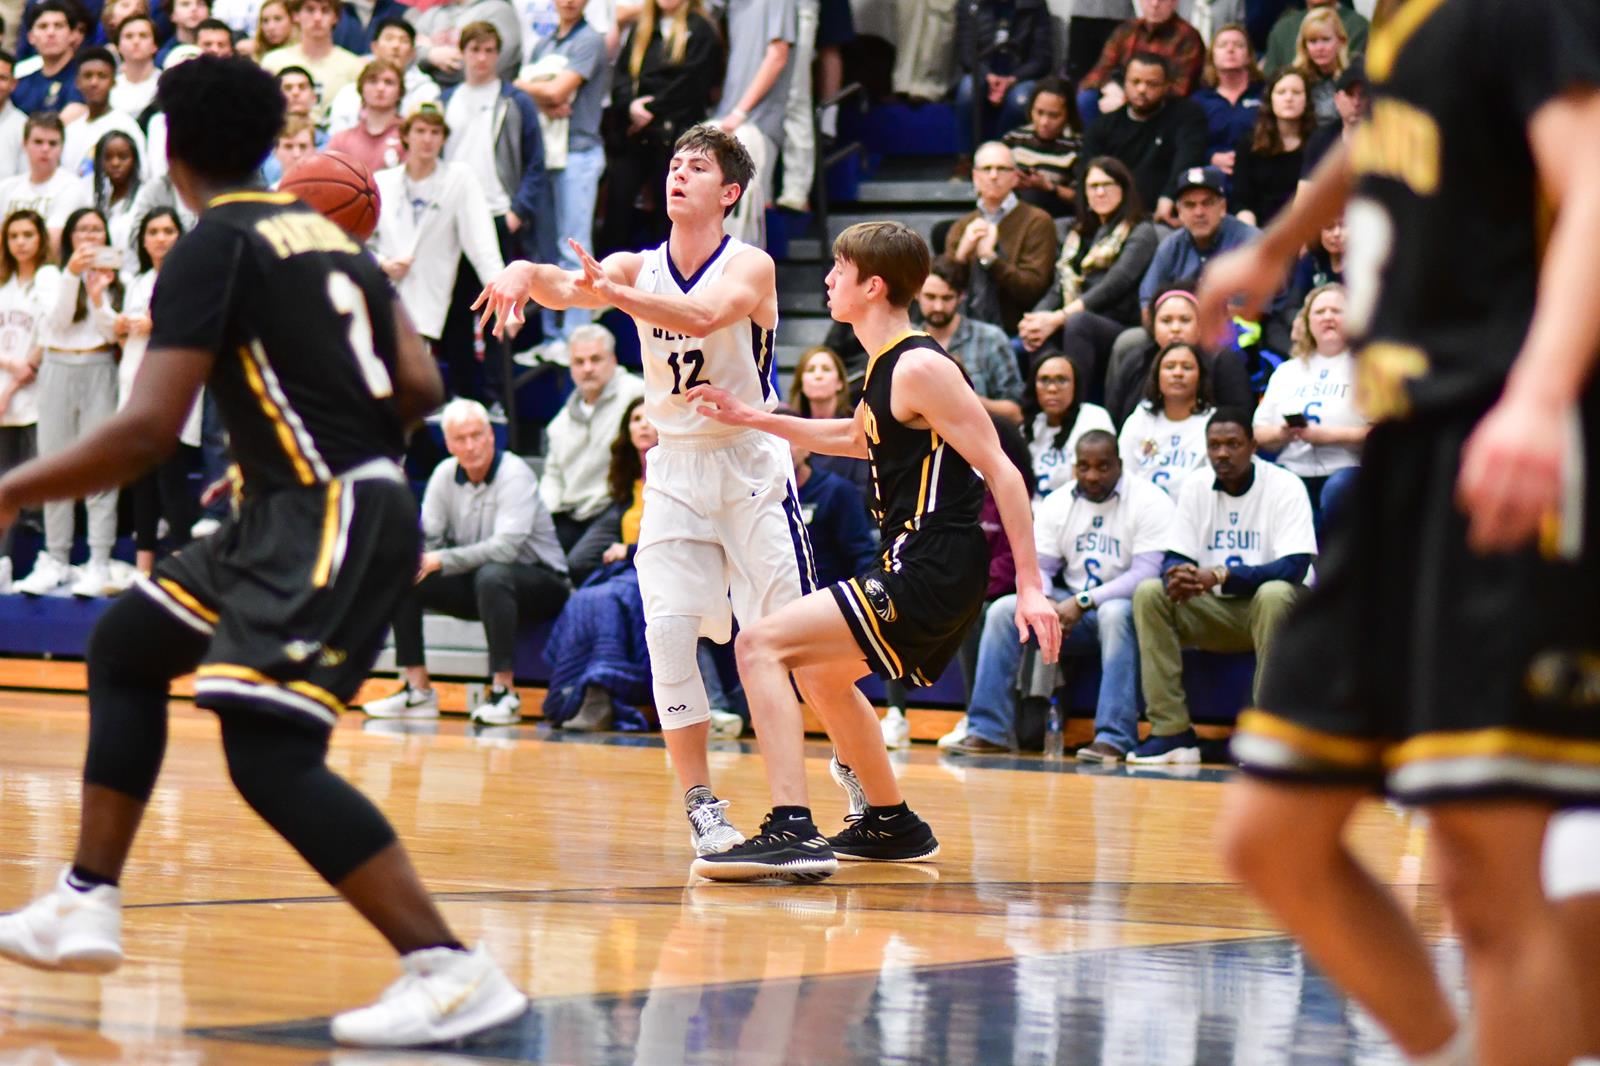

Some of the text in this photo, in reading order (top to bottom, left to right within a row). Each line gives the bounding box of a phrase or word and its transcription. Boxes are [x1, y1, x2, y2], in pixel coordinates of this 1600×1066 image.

[667, 350, 712, 394] 12
[1075, 532, 1121, 559] ESUIT
[1207, 530, 1261, 552] ESUIT
